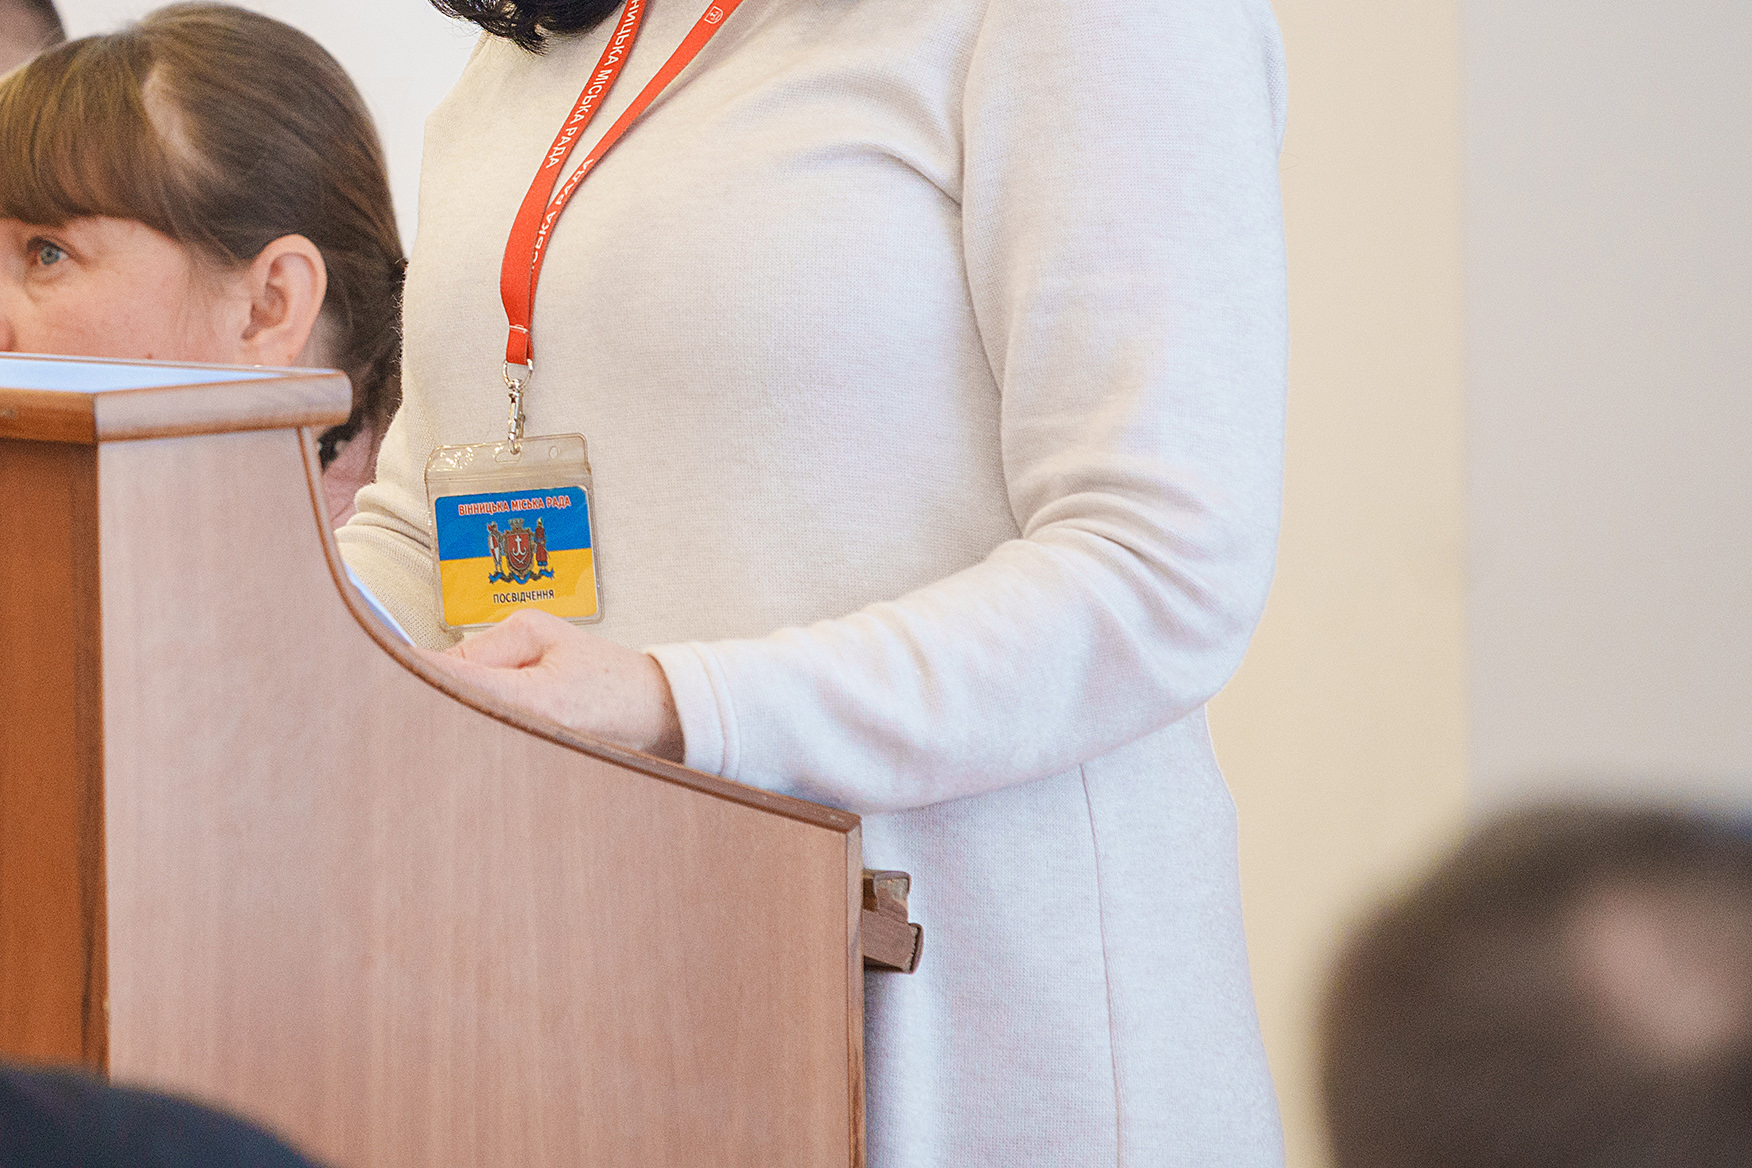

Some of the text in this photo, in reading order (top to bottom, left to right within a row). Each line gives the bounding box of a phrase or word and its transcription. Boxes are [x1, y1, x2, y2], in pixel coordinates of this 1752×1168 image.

[570, 69, 613, 124] МІСЬКА
[546, 127, 578, 168] РАДА
[555, 159, 594, 205] РАДА
[458, 495, 571, 516] ВІННИЦЬКА МІСЬКА РАДА
[492, 589, 555, 604] ПОСВІДЧЕННЯ
